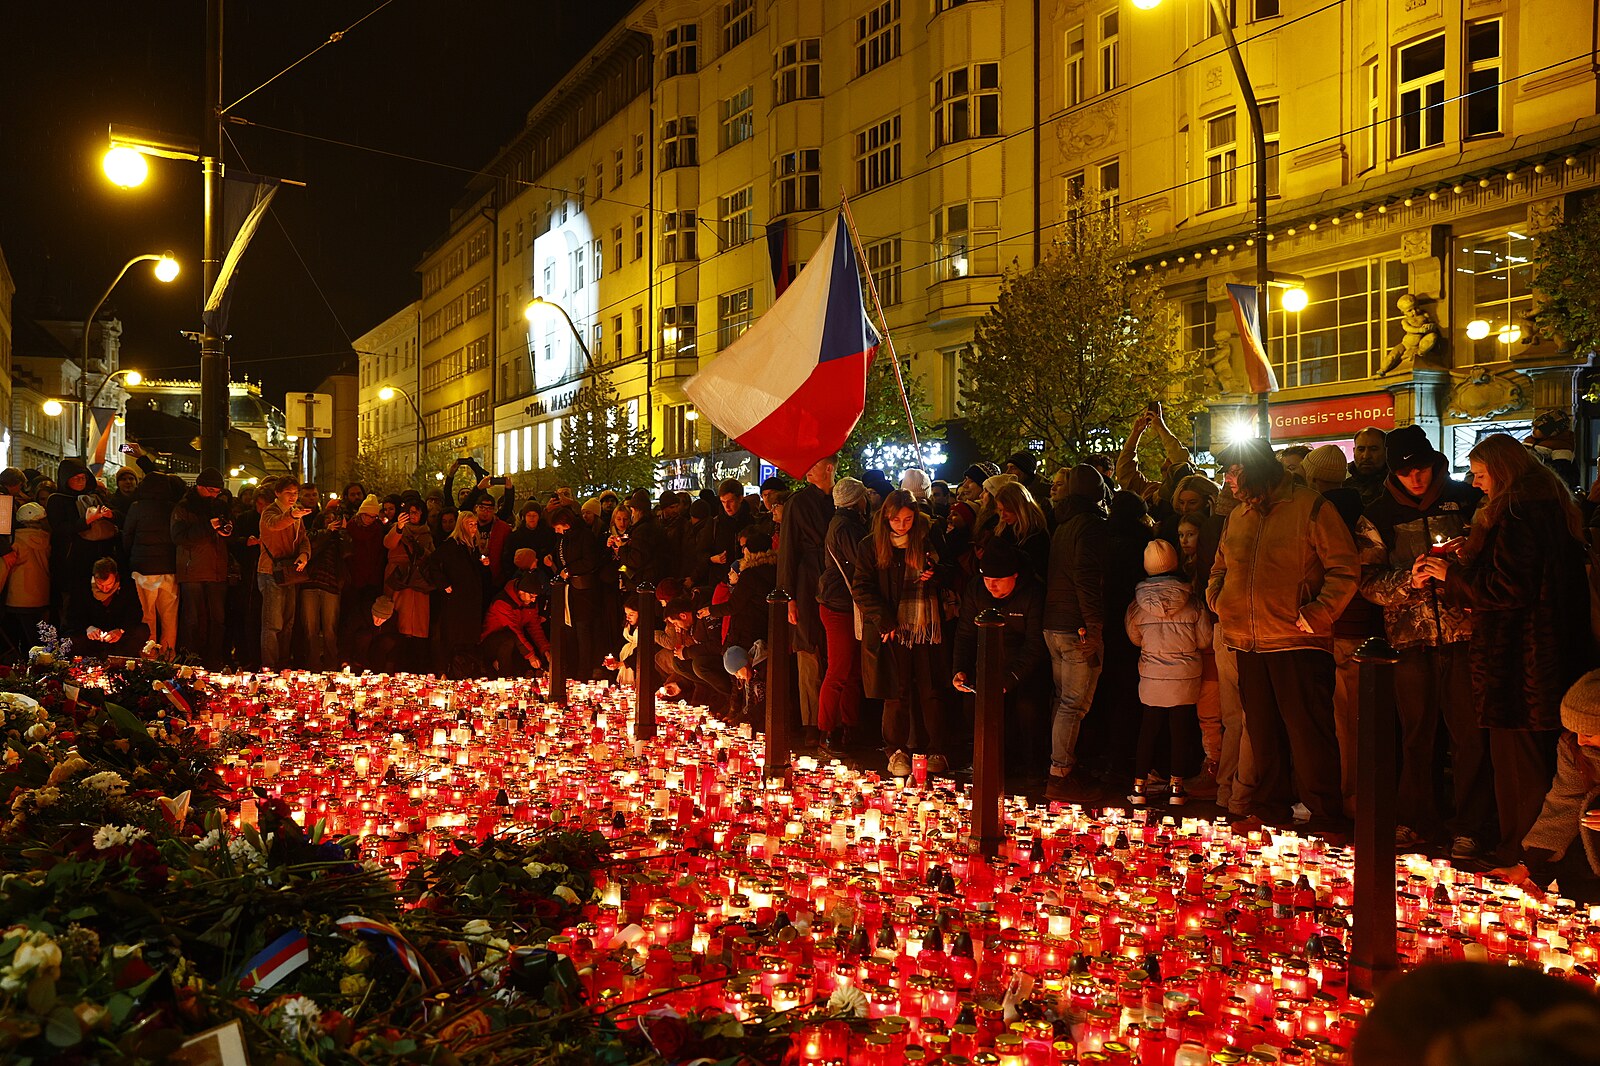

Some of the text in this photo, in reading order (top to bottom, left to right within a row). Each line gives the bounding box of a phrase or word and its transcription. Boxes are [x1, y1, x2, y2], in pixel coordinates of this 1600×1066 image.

[530, 399, 548, 418] THAI
[1275, 407, 1394, 427] Genesis-eshop.c
[763, 466, 773, 480] P
